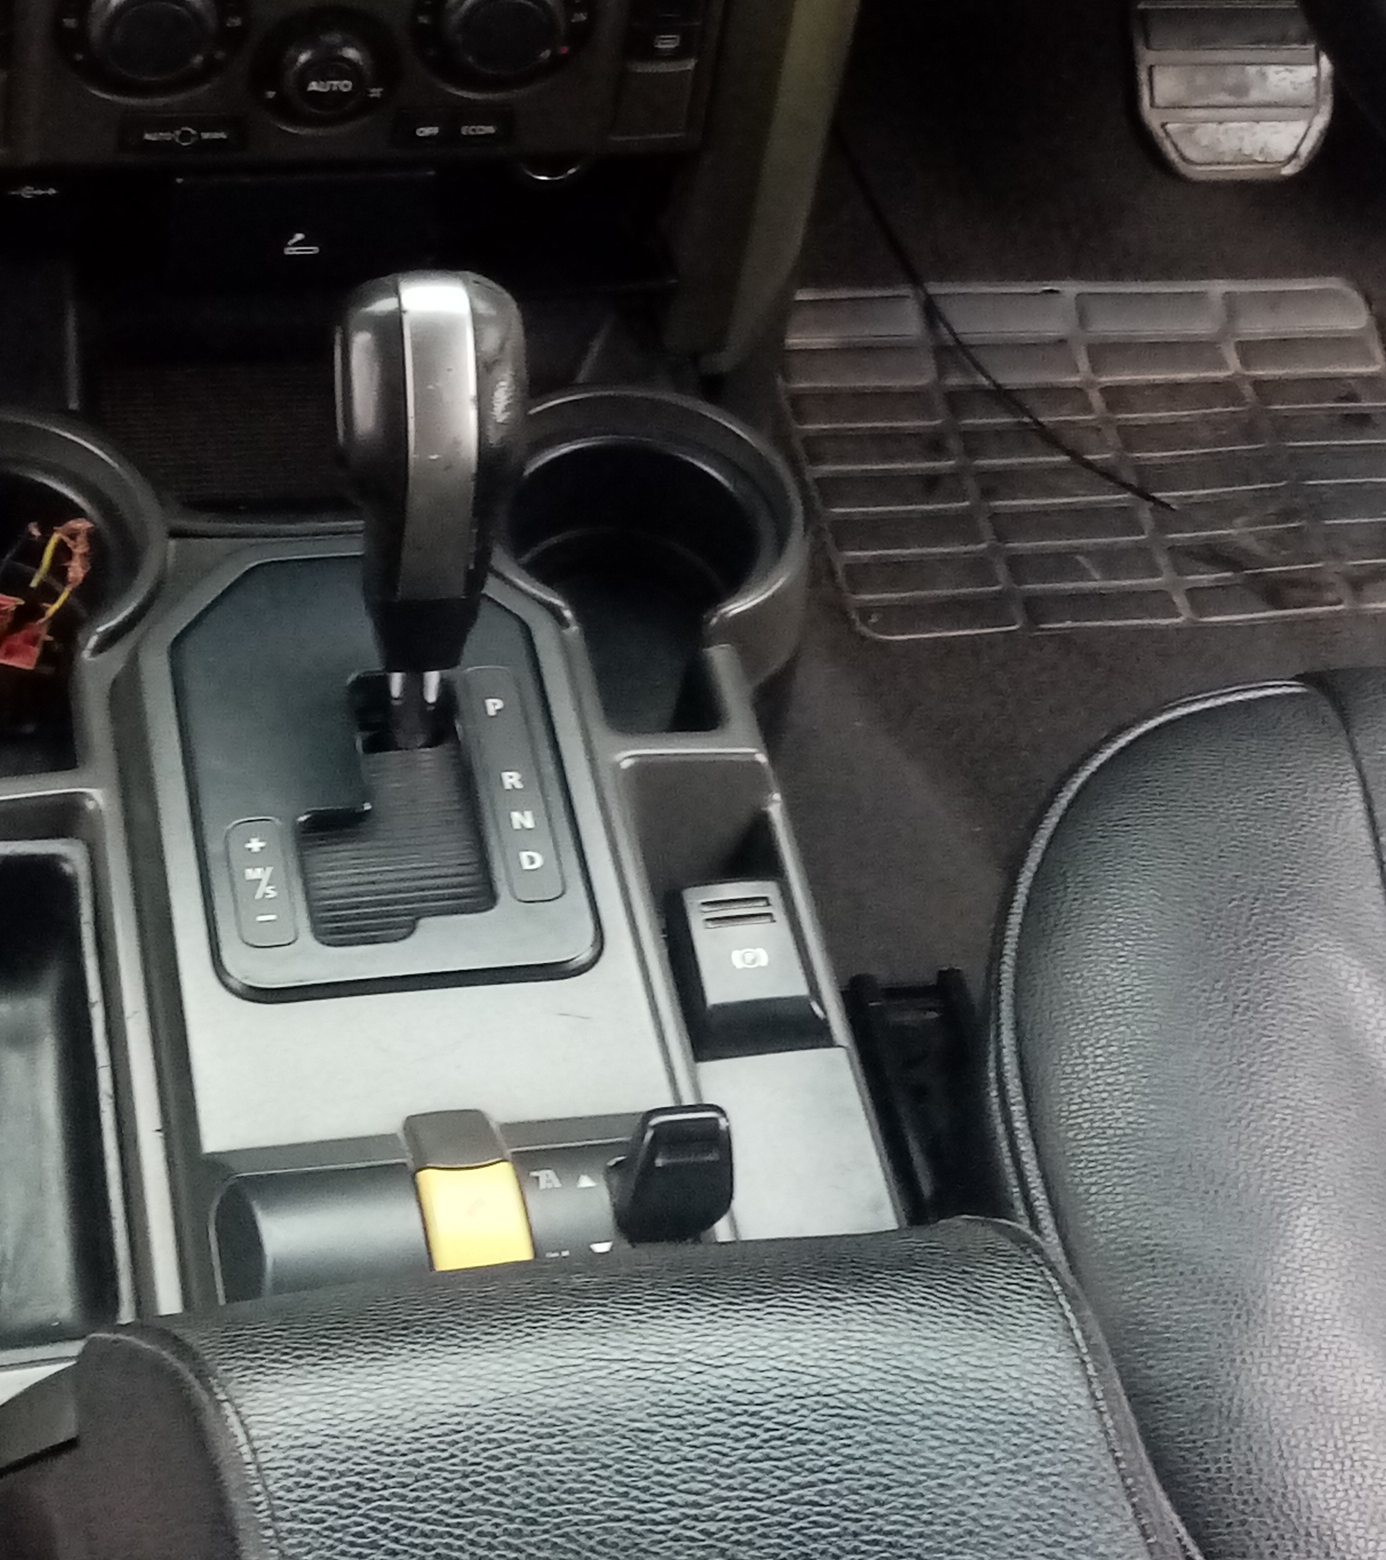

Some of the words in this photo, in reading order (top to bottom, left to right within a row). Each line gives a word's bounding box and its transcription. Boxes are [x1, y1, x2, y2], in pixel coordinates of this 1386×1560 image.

[306, 79, 353, 92] AUTO
[485, 697, 504, 717] P
[501, 770, 524, 790] R
[510, 810, 535, 830] N
[518, 850, 544, 871] D
